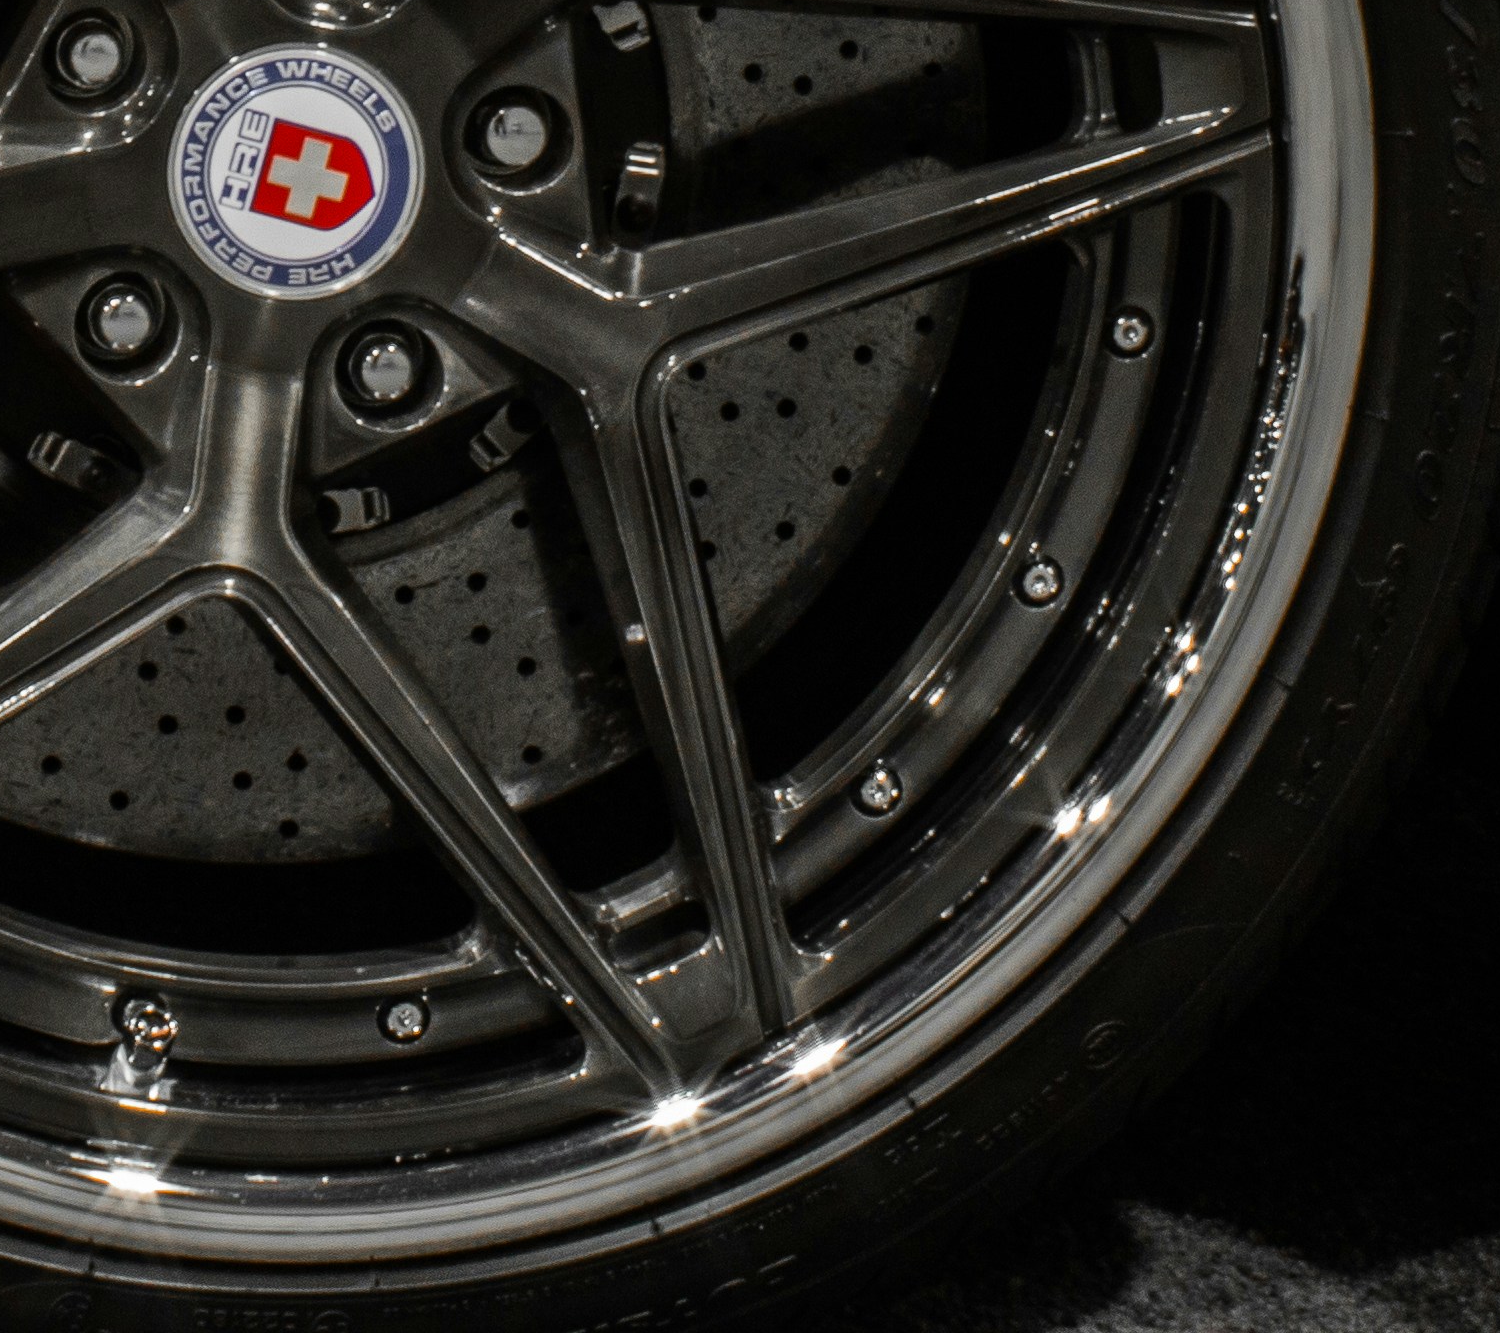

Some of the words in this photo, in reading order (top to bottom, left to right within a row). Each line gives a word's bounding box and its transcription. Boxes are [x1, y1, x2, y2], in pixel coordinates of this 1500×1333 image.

[276, 60, 398, 133] WHEELS
[182, 67, 276, 282] PERFORMANCE
[220, 107, 270, 211] HRE
[287, 252, 357, 285] HRE
